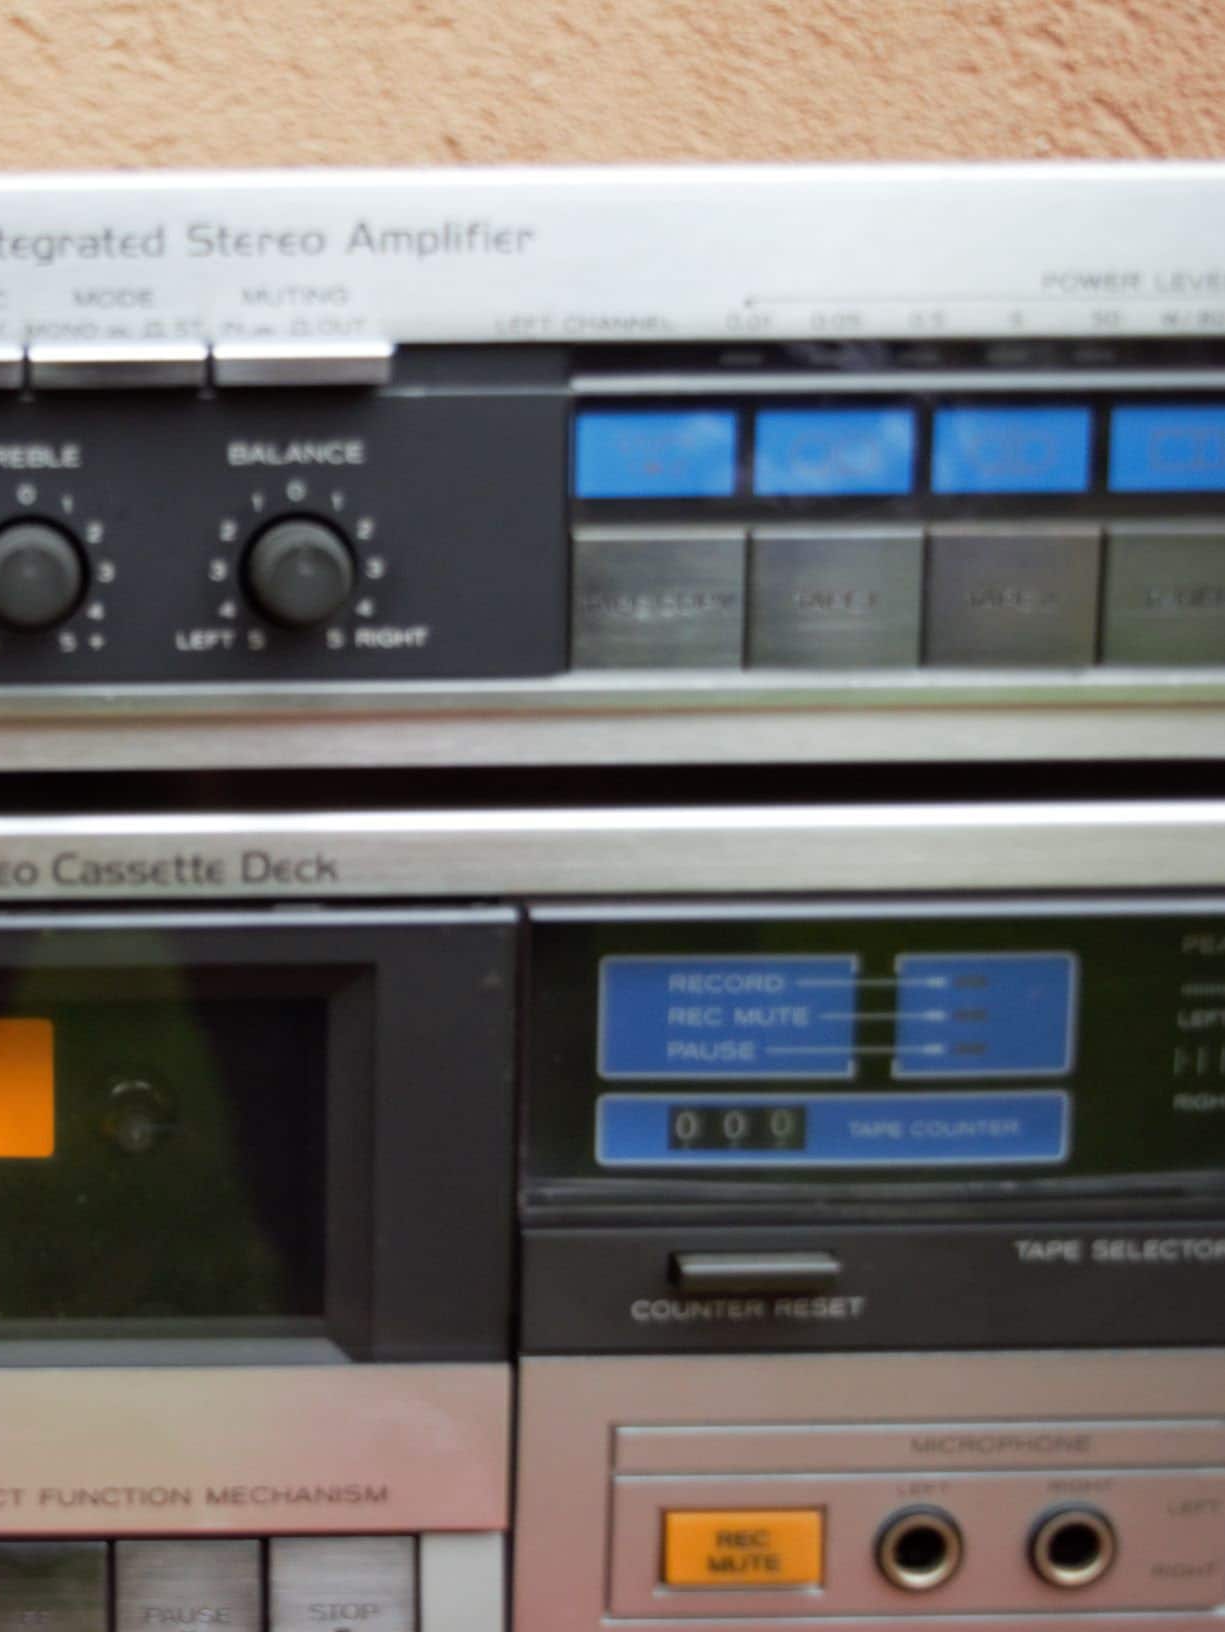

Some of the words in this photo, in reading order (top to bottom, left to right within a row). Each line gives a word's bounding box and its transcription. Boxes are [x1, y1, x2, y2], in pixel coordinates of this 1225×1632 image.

[185, 221, 327, 259] Stereo
[346, 219, 536, 260] Amplifier
[1041, 271, 1141, 294] POWER
[1154, 270, 1225, 293] LEVE
[72, 287, 154, 309] MODE
[241, 286, 350, 308] MUTING
[26, 321, 99, 340] MONO
[495, 316, 553, 335] LEFT
[562, 314, 678, 334] CHANNEL
[227, 440, 364, 466] BALANCE
[16, 483, 37, 506] 0
[286, 478, 307, 502] 0
[62, 494, 74, 514] 1
[252, 492, 264, 512] 1
[332, 491, 344, 512] 1
[86, 521, 104, 544] 2
[220, 519, 237, 542] 2
[356, 516, 374, 540] 2
[97, 560, 115, 583] 3
[209, 558, 227, 582] 3
[365, 555, 384, 579] 3
[87, 601, 104, 620] 4
[218, 599, 236, 618] 4
[355, 597, 373, 617] 4
[59, 630, 77, 652] 5
[174, 628, 235, 650] LEFT
[248, 628, 266, 650] 5
[327, 627, 345, 648] 5
[354, 626, 429, 647] RIGHT
[50, 853, 226, 888] Cassette
[241, 849, 338, 885] Deck
[667, 972, 785, 993] RECORD
[667, 1006, 725, 1027] REC
[734, 1005, 811, 1027] MUTE
[666, 1040, 756, 1061] PAUSE
[675, 1110, 699, 1141] 0
[723, 1109, 746, 1140] 0
[770, 1108, 794, 1138] 0
[848, 1118, 903, 1139] TAPE
[910, 1117, 1021, 1138] COUNTER
[1014, 1239, 1083, 1262] TAPE
[630, 1299, 766, 1322] COUNTER
[774, 1296, 865, 1319] RESET
[910, 1435, 1092, 1456] MICROPHONE
[38, 1485, 193, 1508] FUNCTION
[206, 1482, 389, 1506] MECHANISM
[895, 1481, 951, 1497] LEFT
[1047, 1477, 1115, 1494] RIGHT
[1166, 1498, 1222, 1517] LEFT
[714, 1529, 771, 1549] REC
[706, 1553, 783, 1574] MUTE
[1151, 1561, 1218, 1579] RIGHT
[143, 1606, 232, 1626] PAUSE
[308, 1602, 381, 1623] STOP
